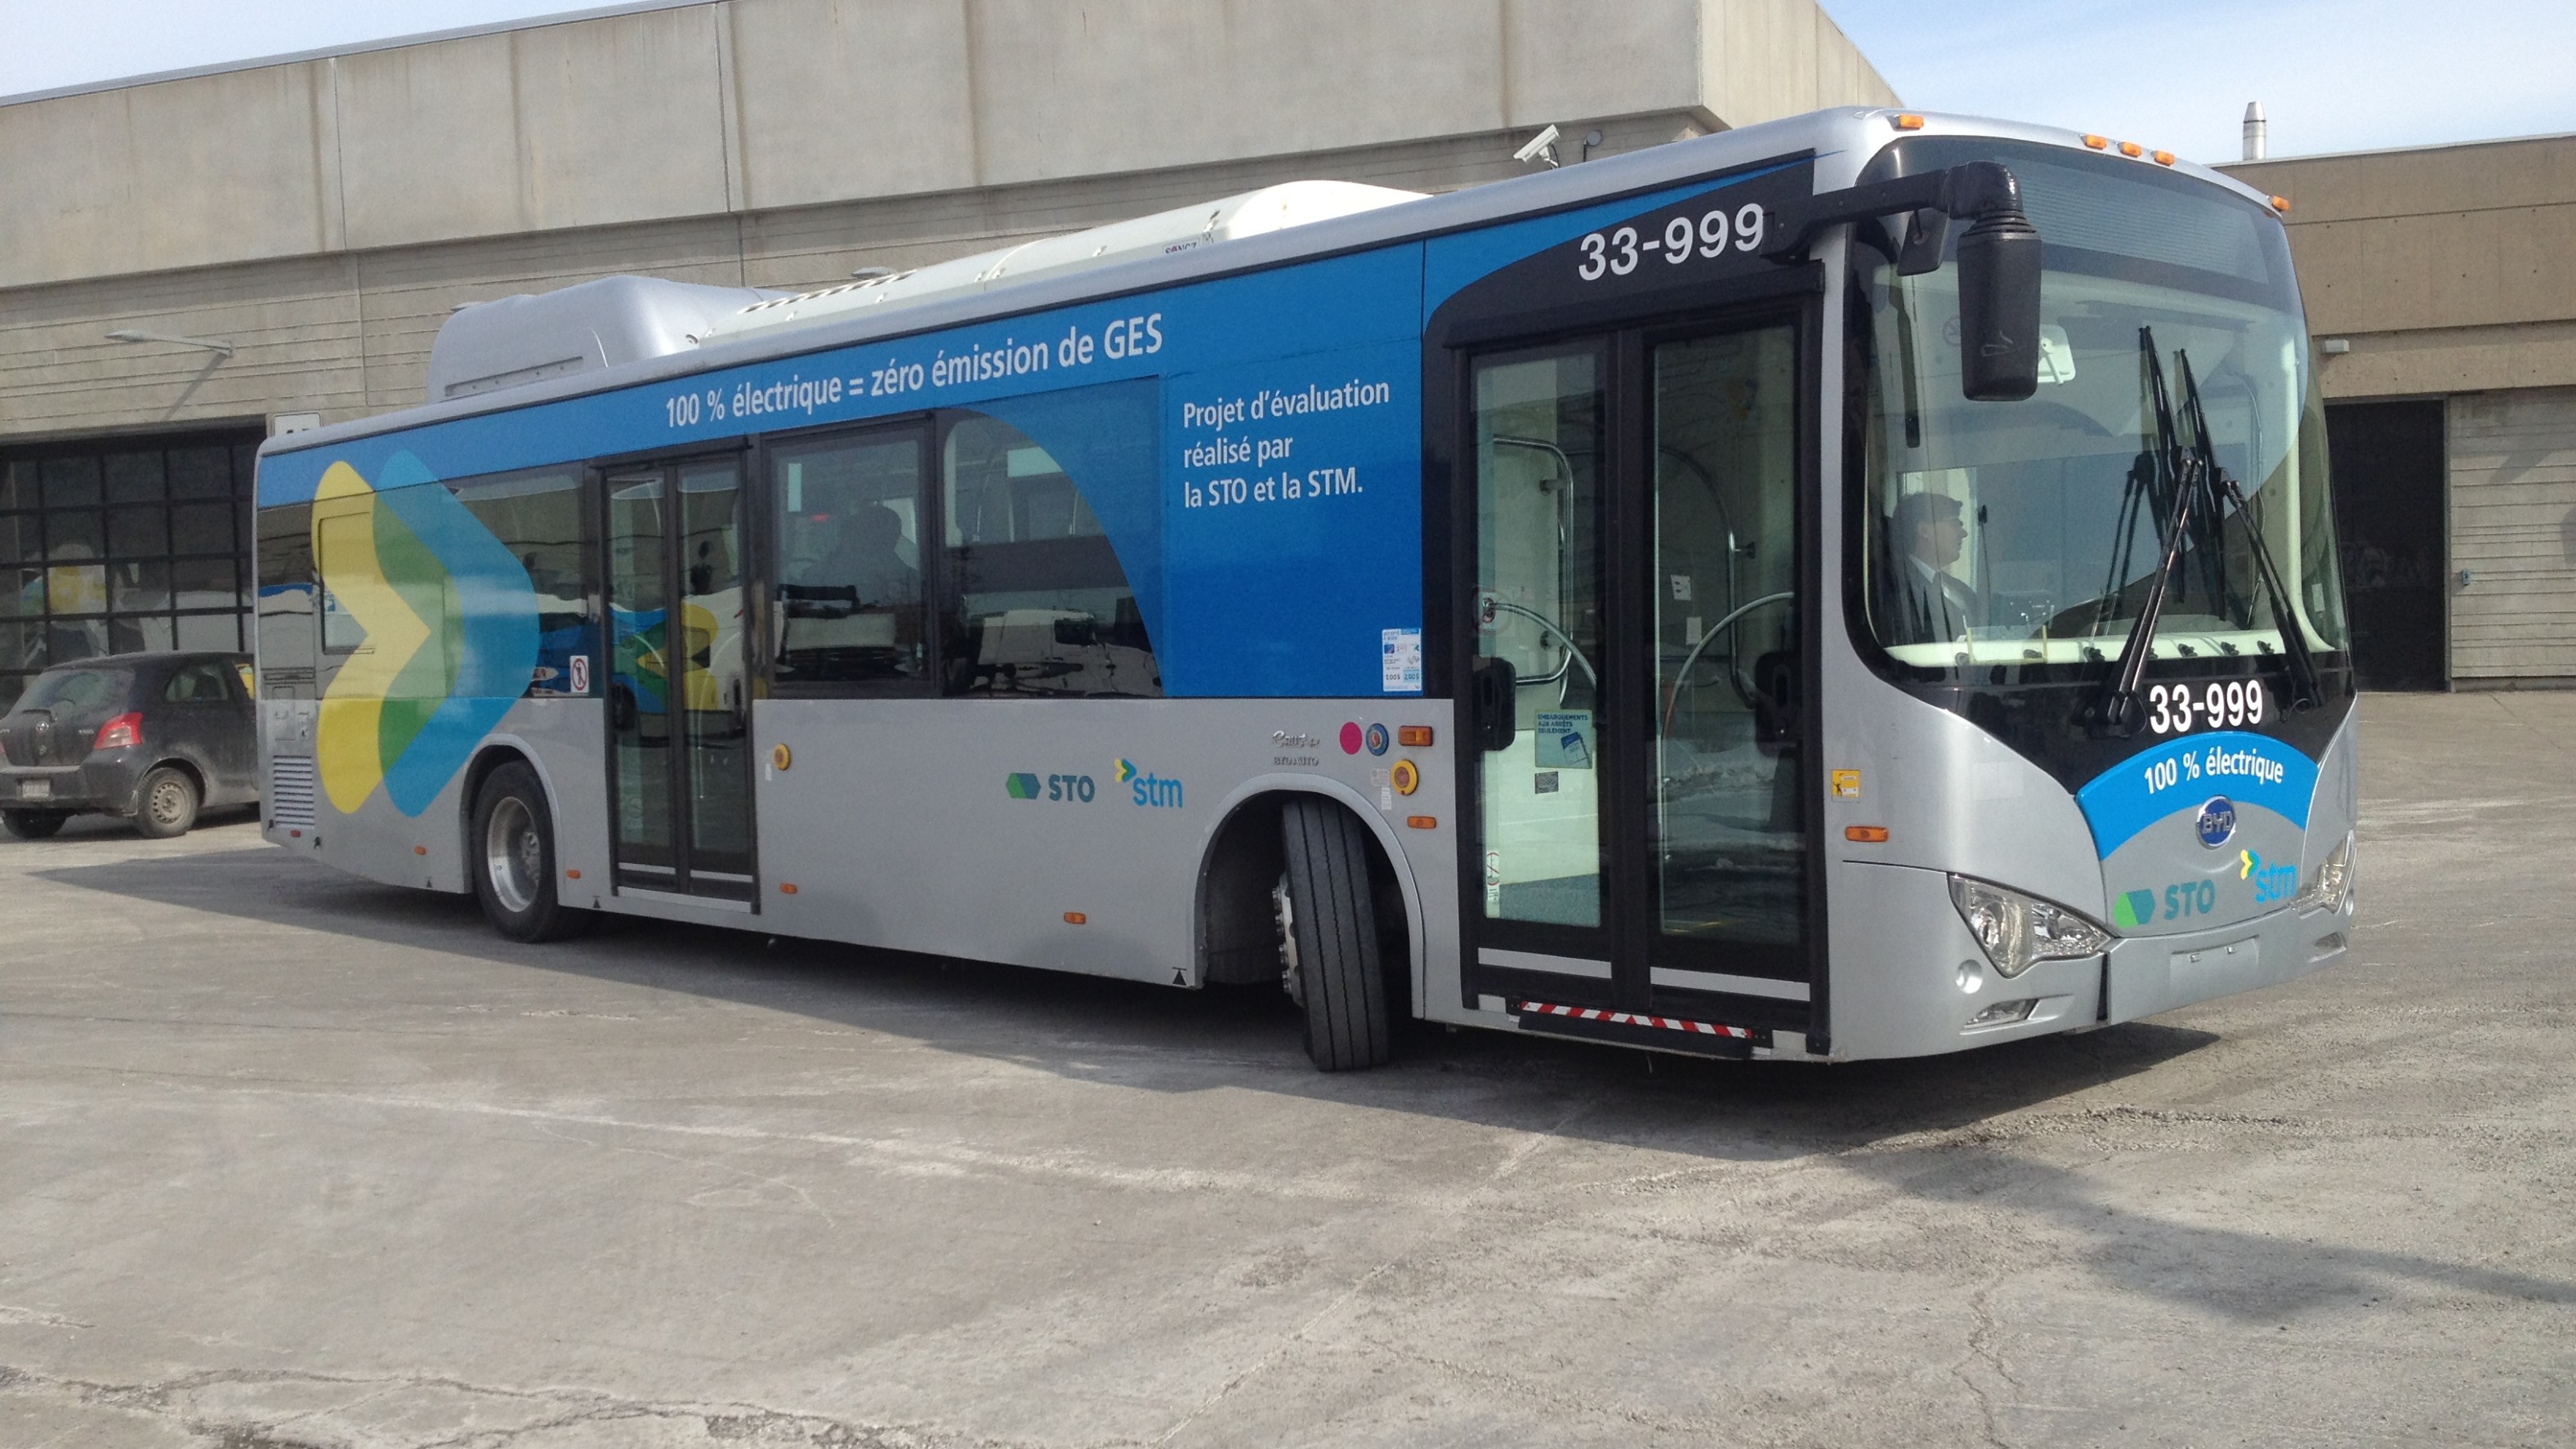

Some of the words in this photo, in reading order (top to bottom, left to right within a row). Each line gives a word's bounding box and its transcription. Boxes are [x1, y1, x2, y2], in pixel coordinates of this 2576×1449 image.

[1578, 203, 1764, 281] 33-999
[666, 393, 699, 427] 100
[707, 388, 725, 421] %
[732, 374, 842, 417] électrique
[849, 378, 864, 396] =
[871, 358, 924, 396] zéro
[932, 338, 1048, 387] émission
[1058, 326, 1094, 367] de
[1104, 313, 1163, 360] GES
[1184, 397, 1244, 432] Projet
[1184, 436, 1251, 468] réalisé
[1257, 437, 1293, 467] par
[1185, 481, 1202, 508] la
[1208, 478, 1247, 506] STO
[1253, 476, 1275, 502] et
[1282, 472, 1301, 499] la
[1308, 467, 1363, 497] STM.
[2150, 679, 2263, 734] 33-999
[1047, 773, 1096, 803] STO
[1132, 772, 1184, 808] stm
[2144, 758, 2177, 794] 100
[2182, 750, 2200, 781] %
[2205, 745, 2284, 785] électrique
[2201, 811, 2233, 834] BYD
[2163, 879, 2215, 920] STO
[2255, 861, 2297, 904] stm
